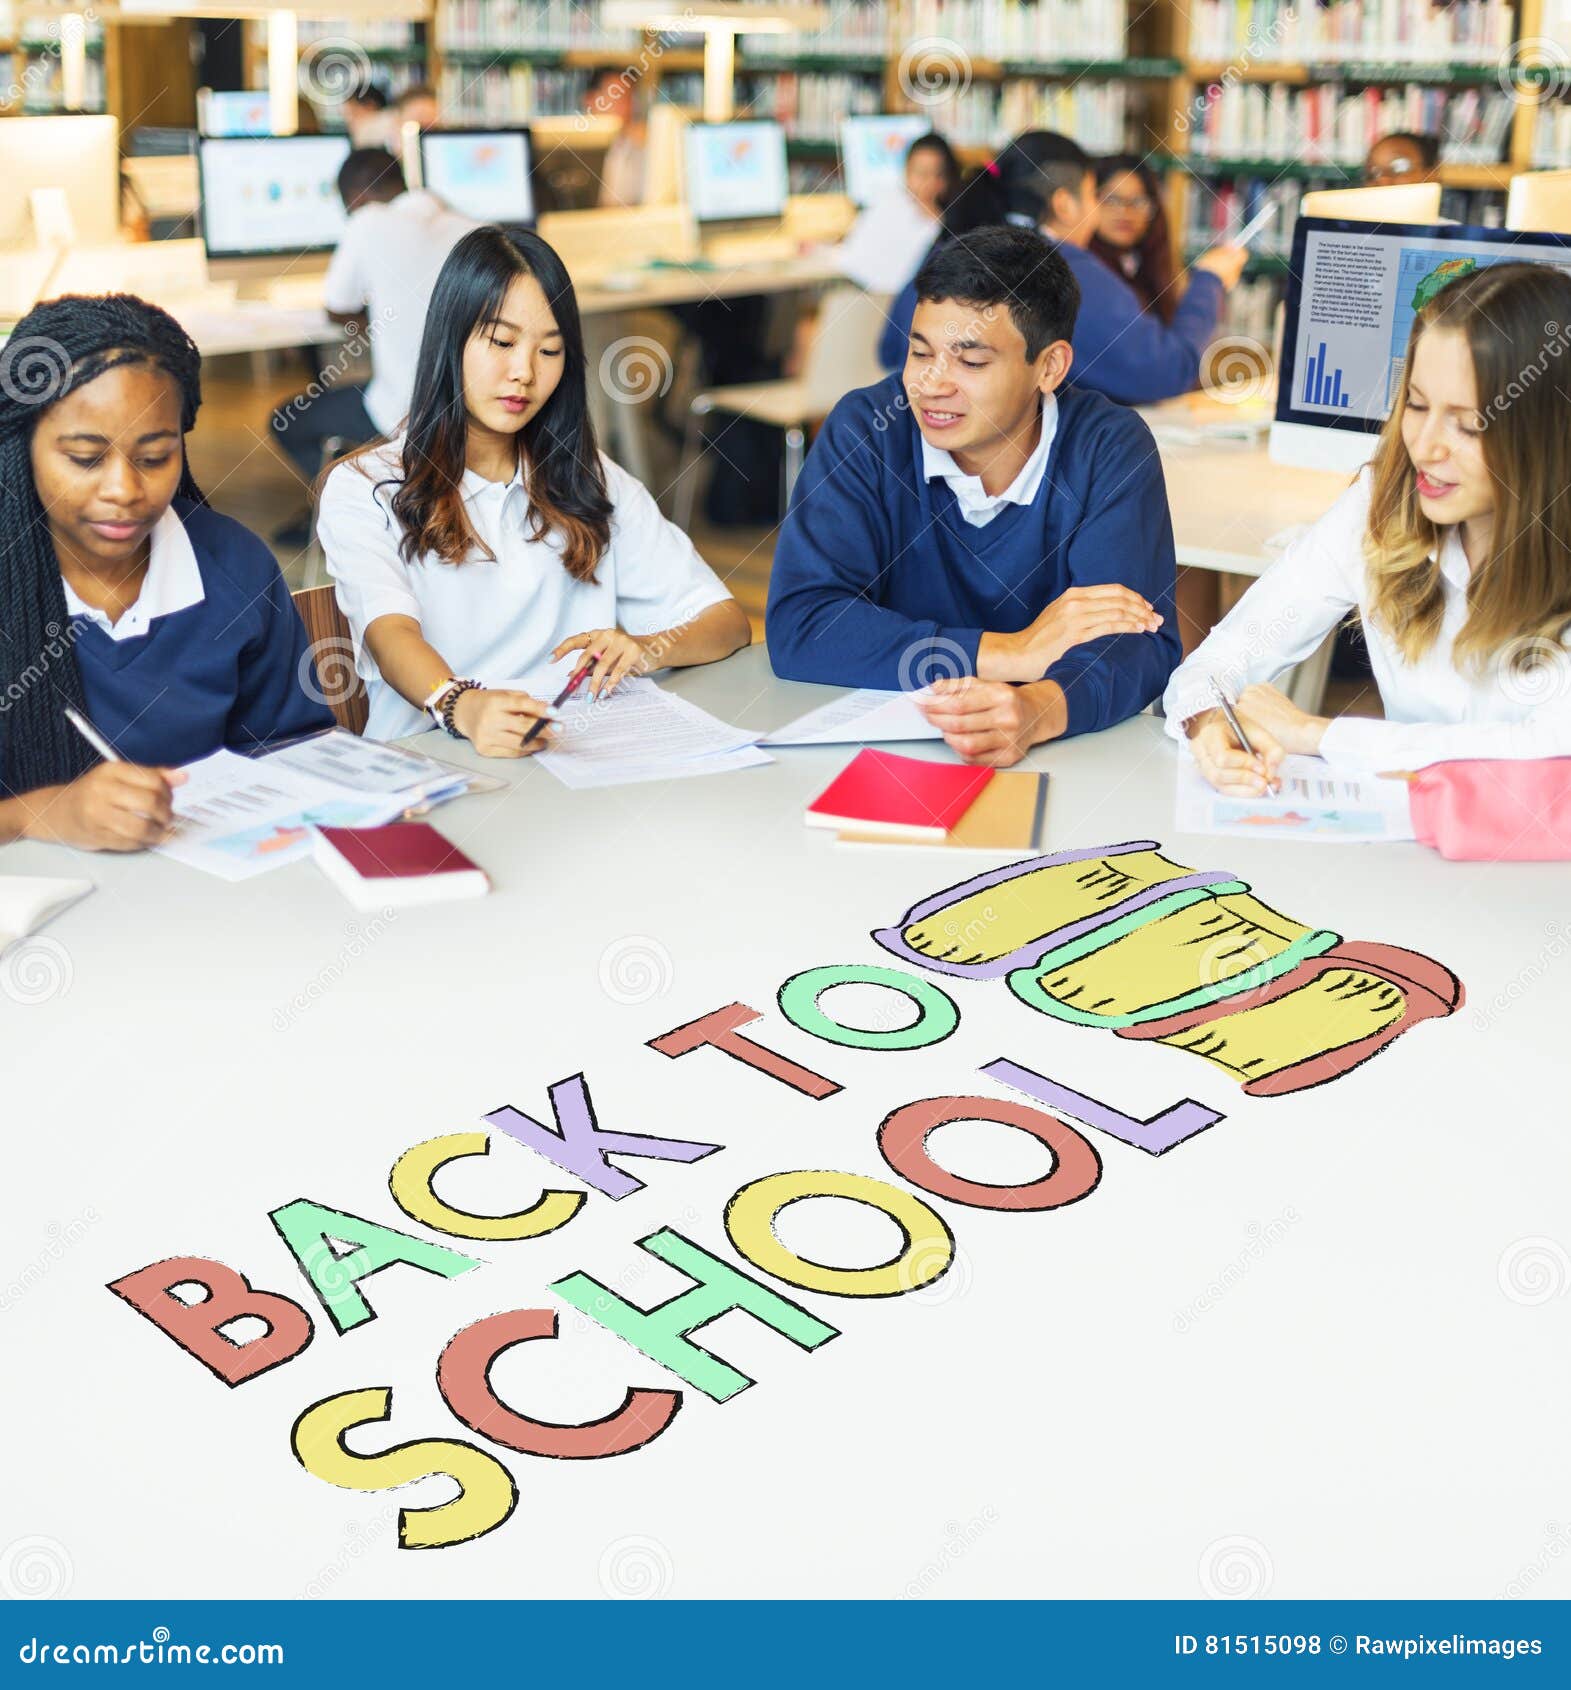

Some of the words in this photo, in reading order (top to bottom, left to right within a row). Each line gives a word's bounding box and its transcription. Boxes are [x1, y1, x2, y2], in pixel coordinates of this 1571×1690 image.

[105, 1072, 727, 1389] BACK
[643, 963, 962, 1101] TO
[290, 1057, 1228, 1550] SCHOOL
